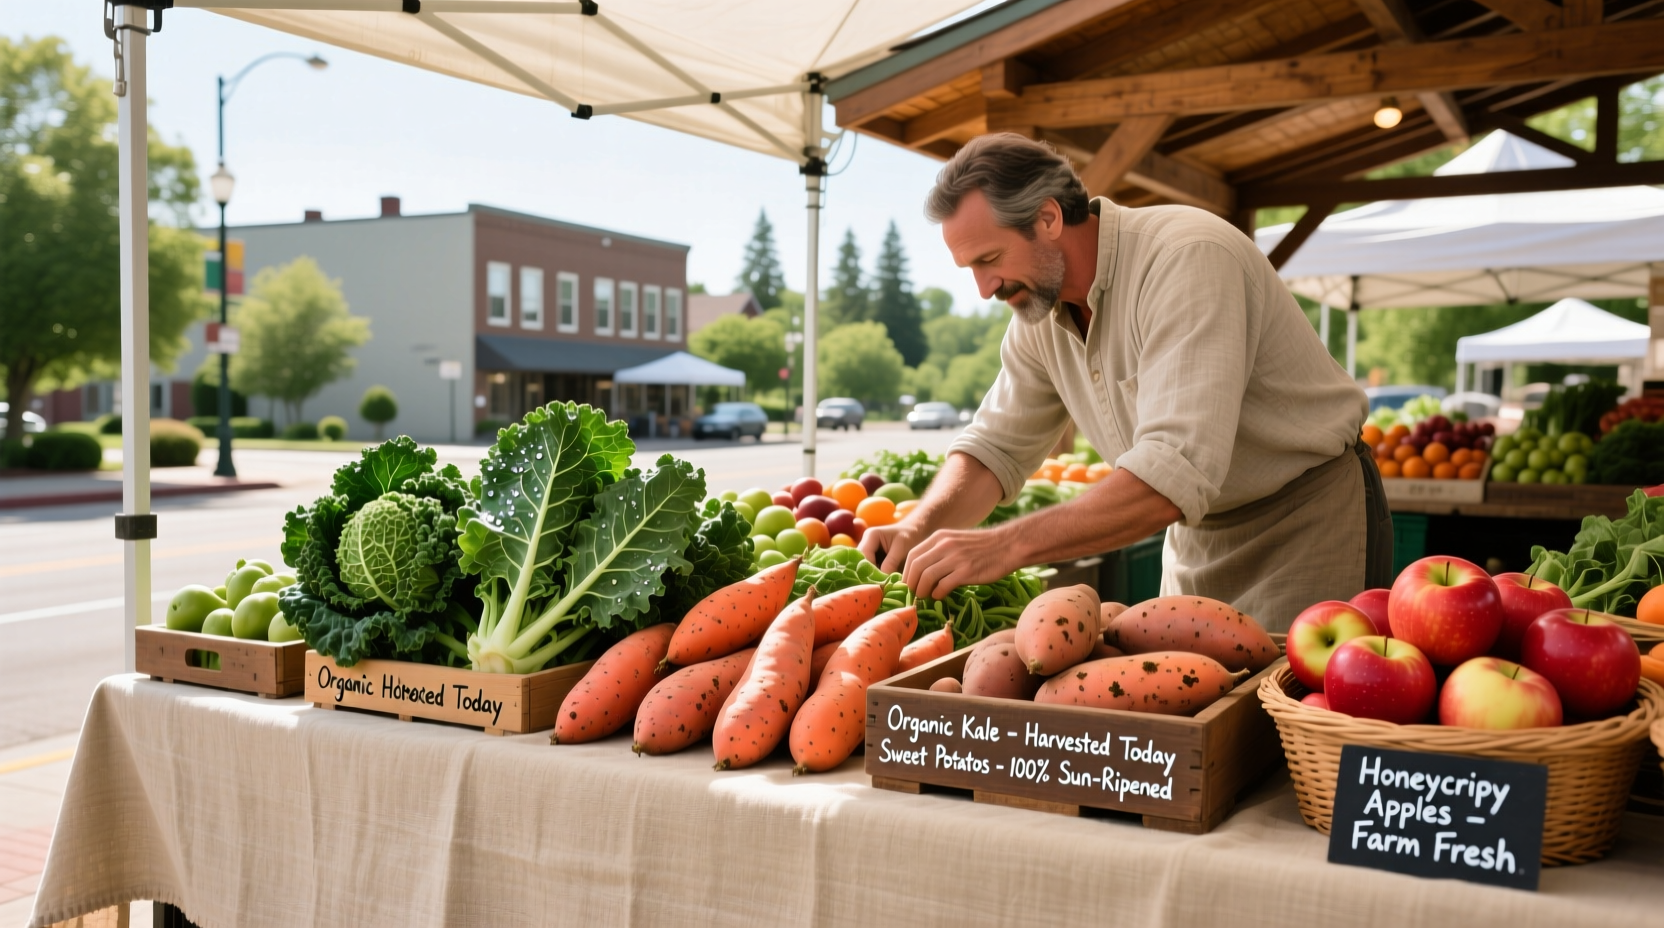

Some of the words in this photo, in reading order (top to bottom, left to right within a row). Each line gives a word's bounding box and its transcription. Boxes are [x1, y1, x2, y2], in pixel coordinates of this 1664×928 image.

[453, 684, 503, 726] Today
[887, 704, 953, 743] Organic
[961, 714, 1000, 742] Kale
[1025, 721, 1110, 756] Harvested
[1119, 736, 1176, 777] Today
[878, 738, 928, 767] Sweet
[1009, 756, 1050, 783] 100%
[1058, 760, 1172, 802] Sun-Ripened
[1359, 756, 1510, 815] Honeycripy
[1363, 789, 1452, 829] Apples
[1352, 820, 1420, 857] Farm
